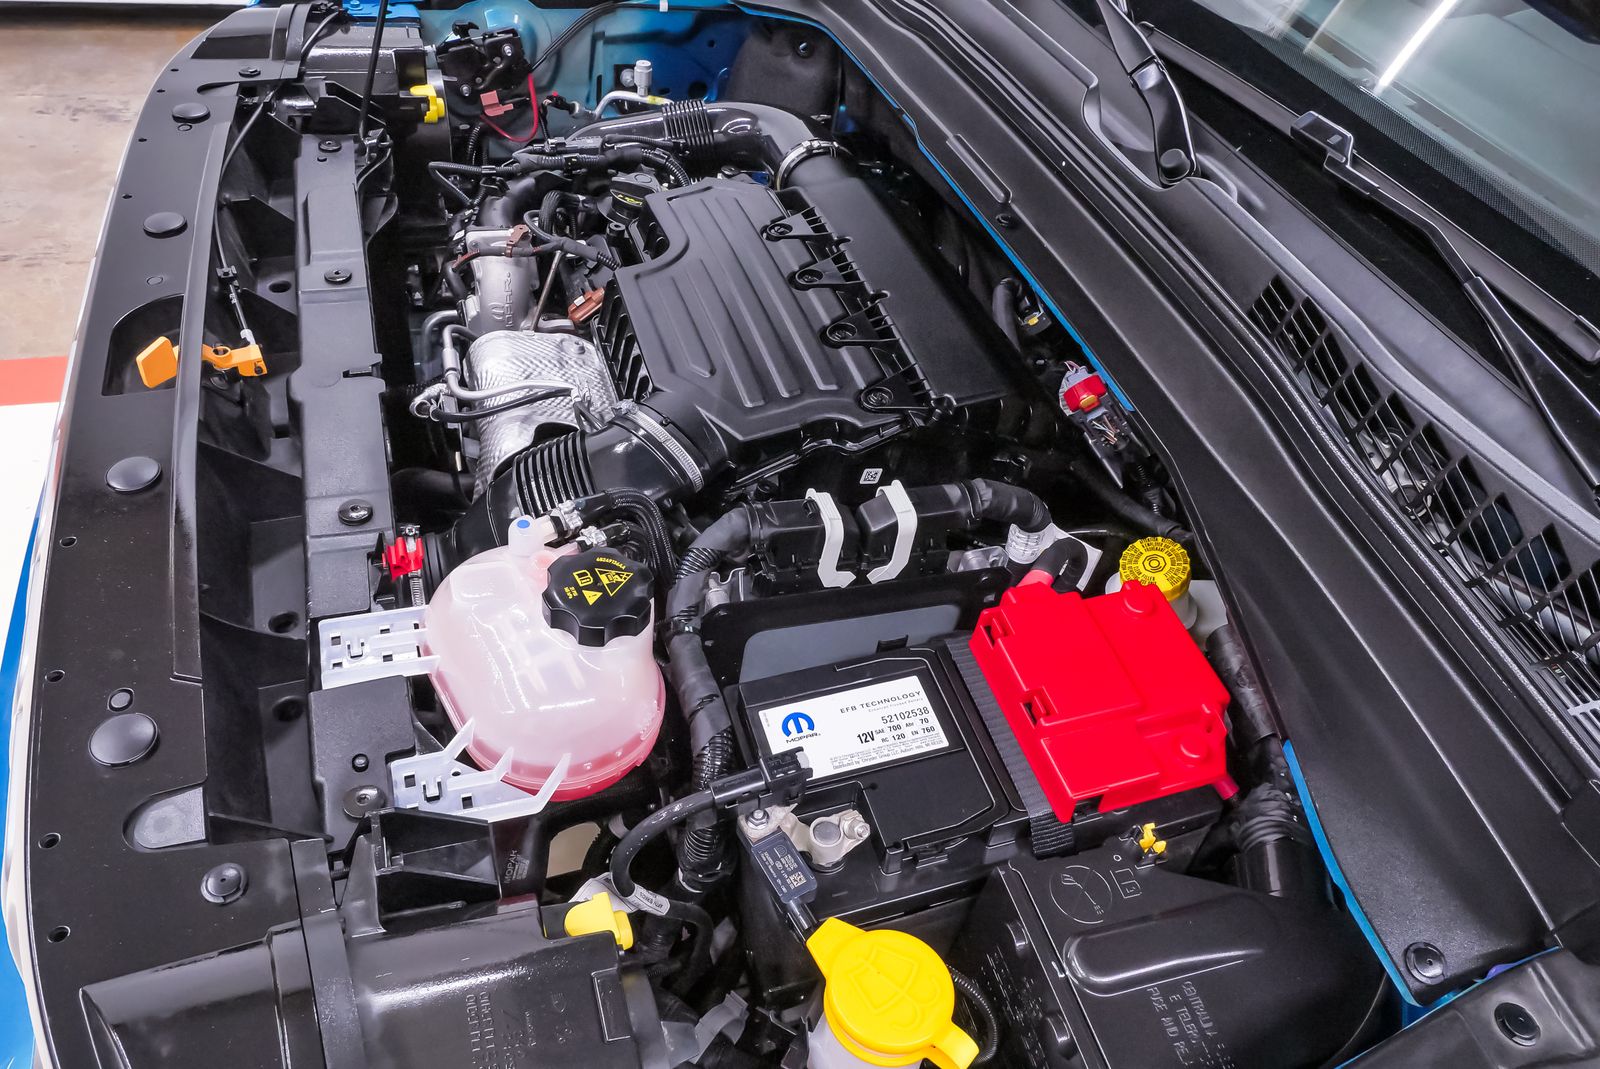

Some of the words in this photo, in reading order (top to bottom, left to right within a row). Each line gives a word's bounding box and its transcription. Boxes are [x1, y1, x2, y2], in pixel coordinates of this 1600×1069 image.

[860, 691, 921, 708] TECHNOLOGY
[881, 706, 930, 724] 52102538
[888, 724, 902, 732] 700
[921, 725, 935, 733] 760
[856, 730, 876, 744] 12V
